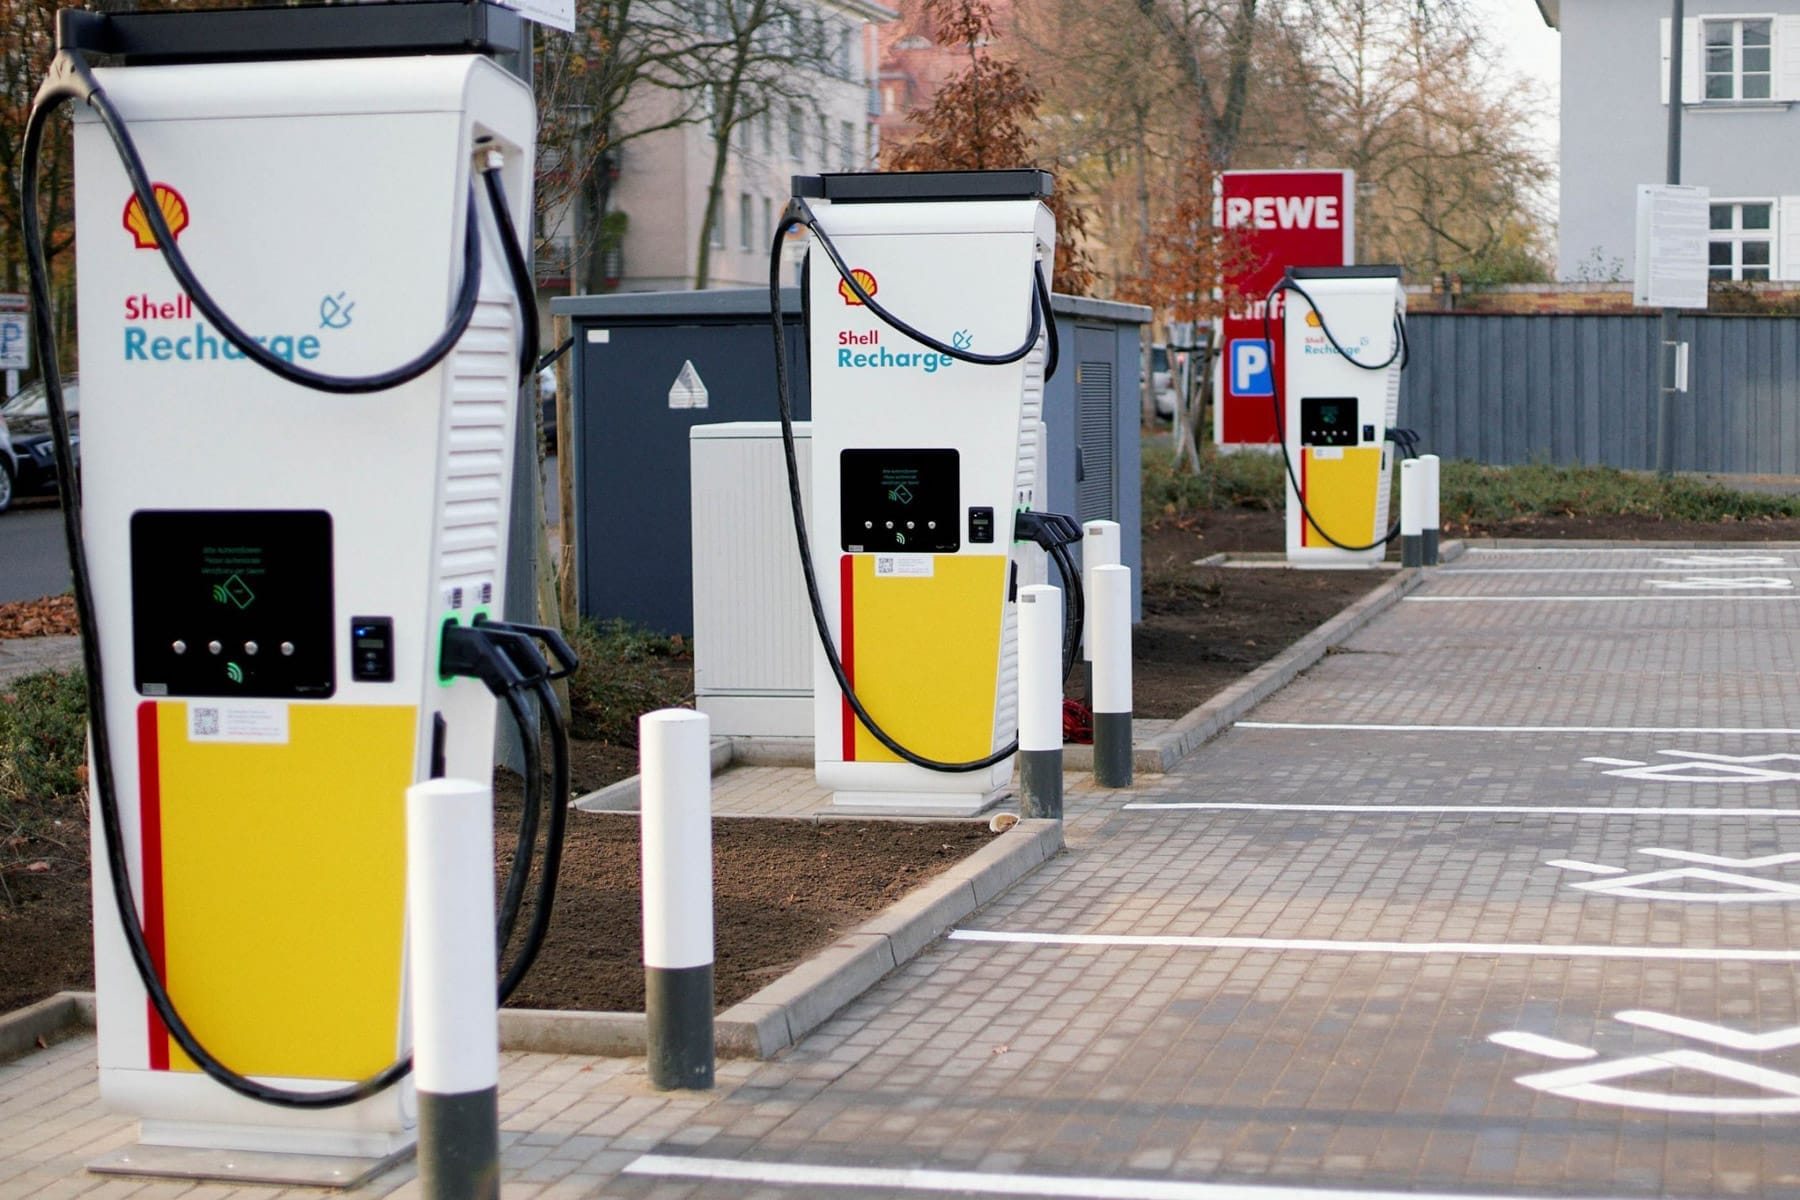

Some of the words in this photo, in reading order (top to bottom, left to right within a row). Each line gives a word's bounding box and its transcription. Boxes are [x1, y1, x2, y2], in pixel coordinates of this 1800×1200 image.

[1226, 196, 1339, 229] REWE
[125, 293, 192, 320] Shell
[838, 330, 879, 345] Shell
[1304, 344, 1361, 356] Rechge
[838, 346, 953, 373] Recharge
[1237, 344, 1267, 390] P
